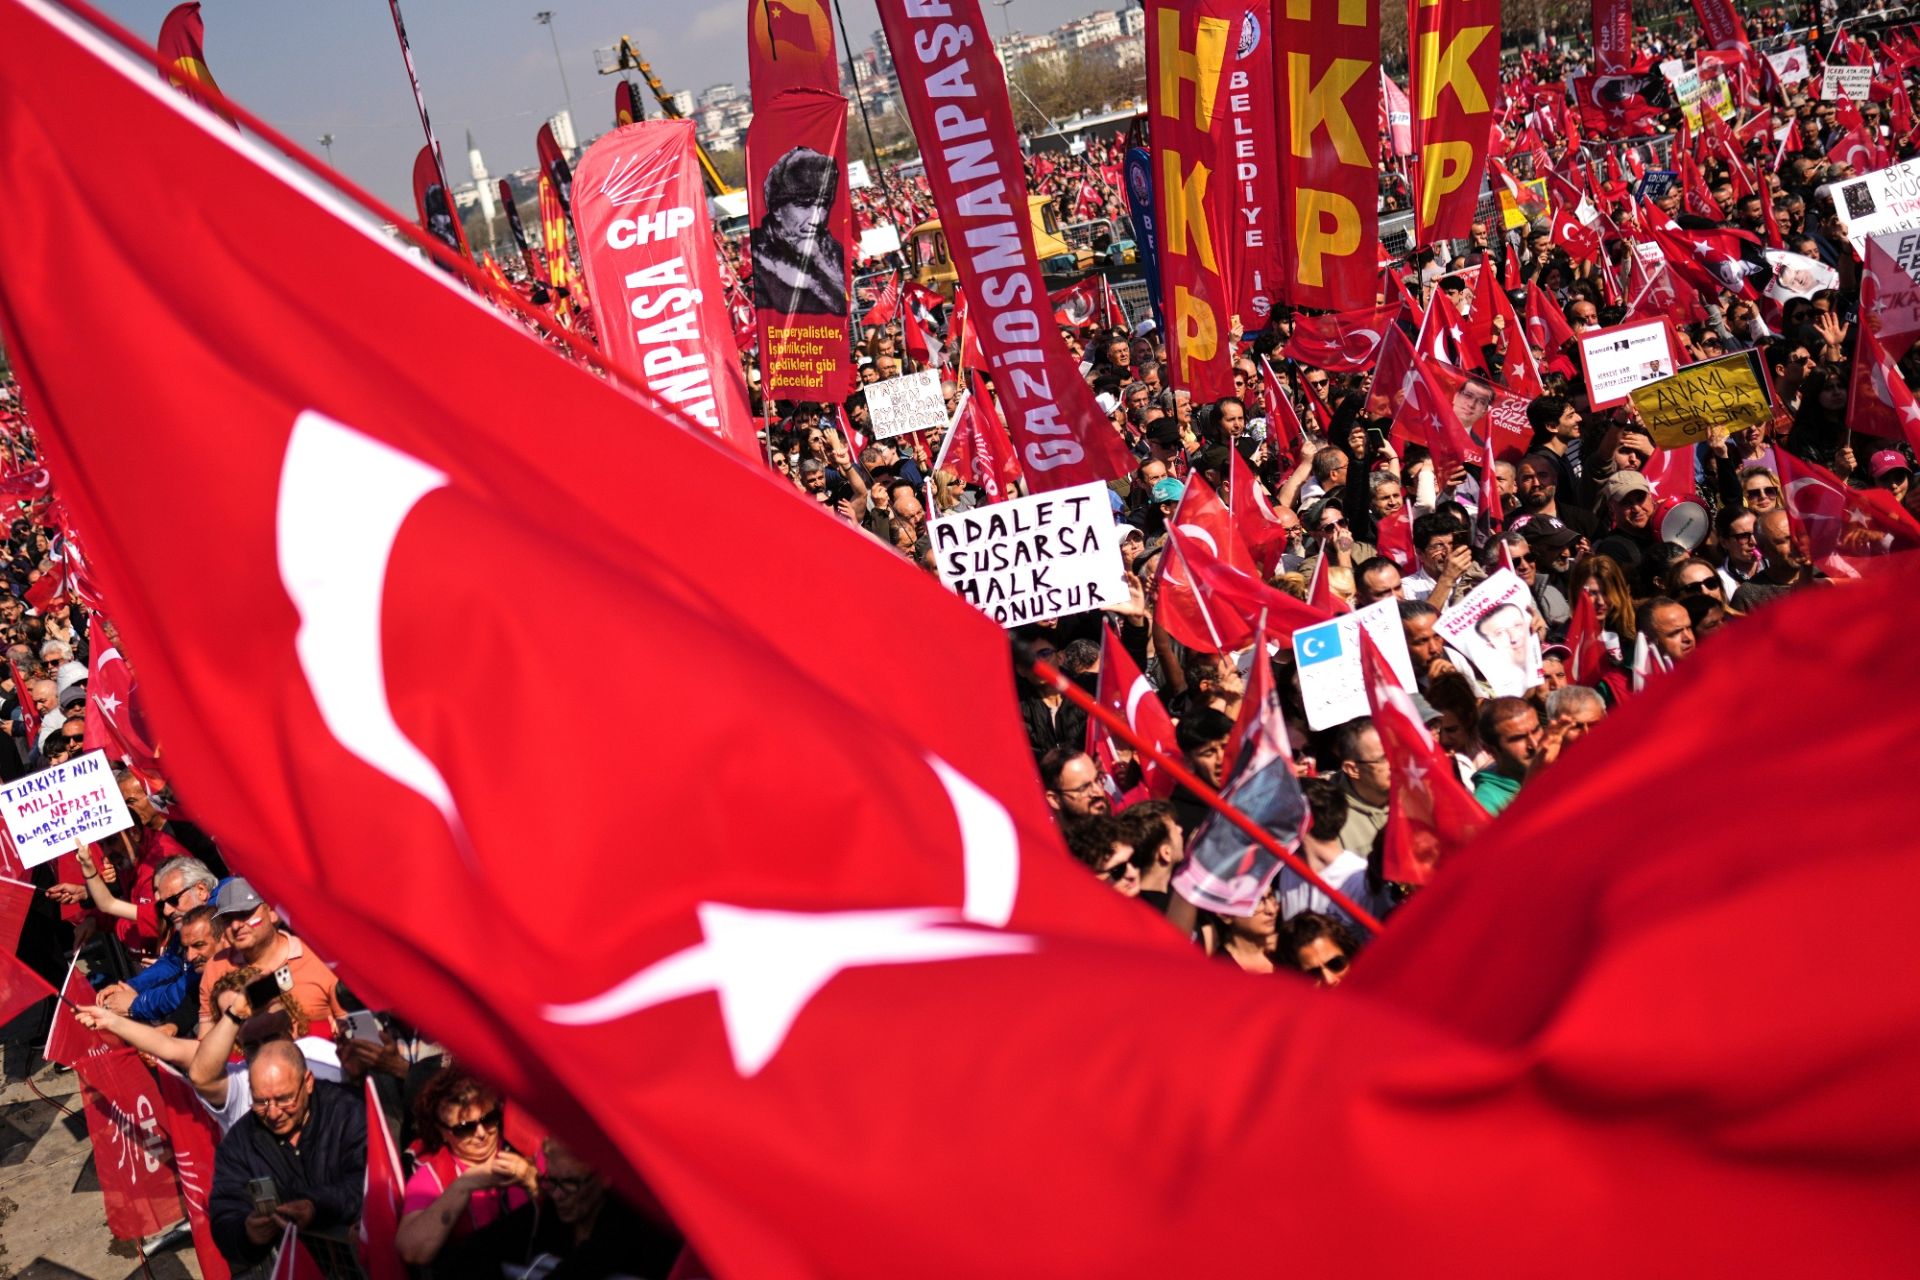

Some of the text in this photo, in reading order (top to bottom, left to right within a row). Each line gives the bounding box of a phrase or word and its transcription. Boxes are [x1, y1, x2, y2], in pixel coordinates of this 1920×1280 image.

[1419, 0, 1495, 228] KP
[1229, 71, 1264, 248] BELEDİYE
[1286, 0, 1374, 288] KP
[606, 207, 695, 250] CHP
[625, 256, 722, 437] ANPAŞA
[815, 358, 836, 374] gibi
[1656, 368, 1726, 411] ANAMI
[935, 496, 1091, 550] ADALET
[947, 525, 1100, 576] SUSARSA
[954, 566, 1053, 604] HALK
[981, 582, 1106, 624] ONUŞUR
[16, 817, 66, 845] OLMAYI
